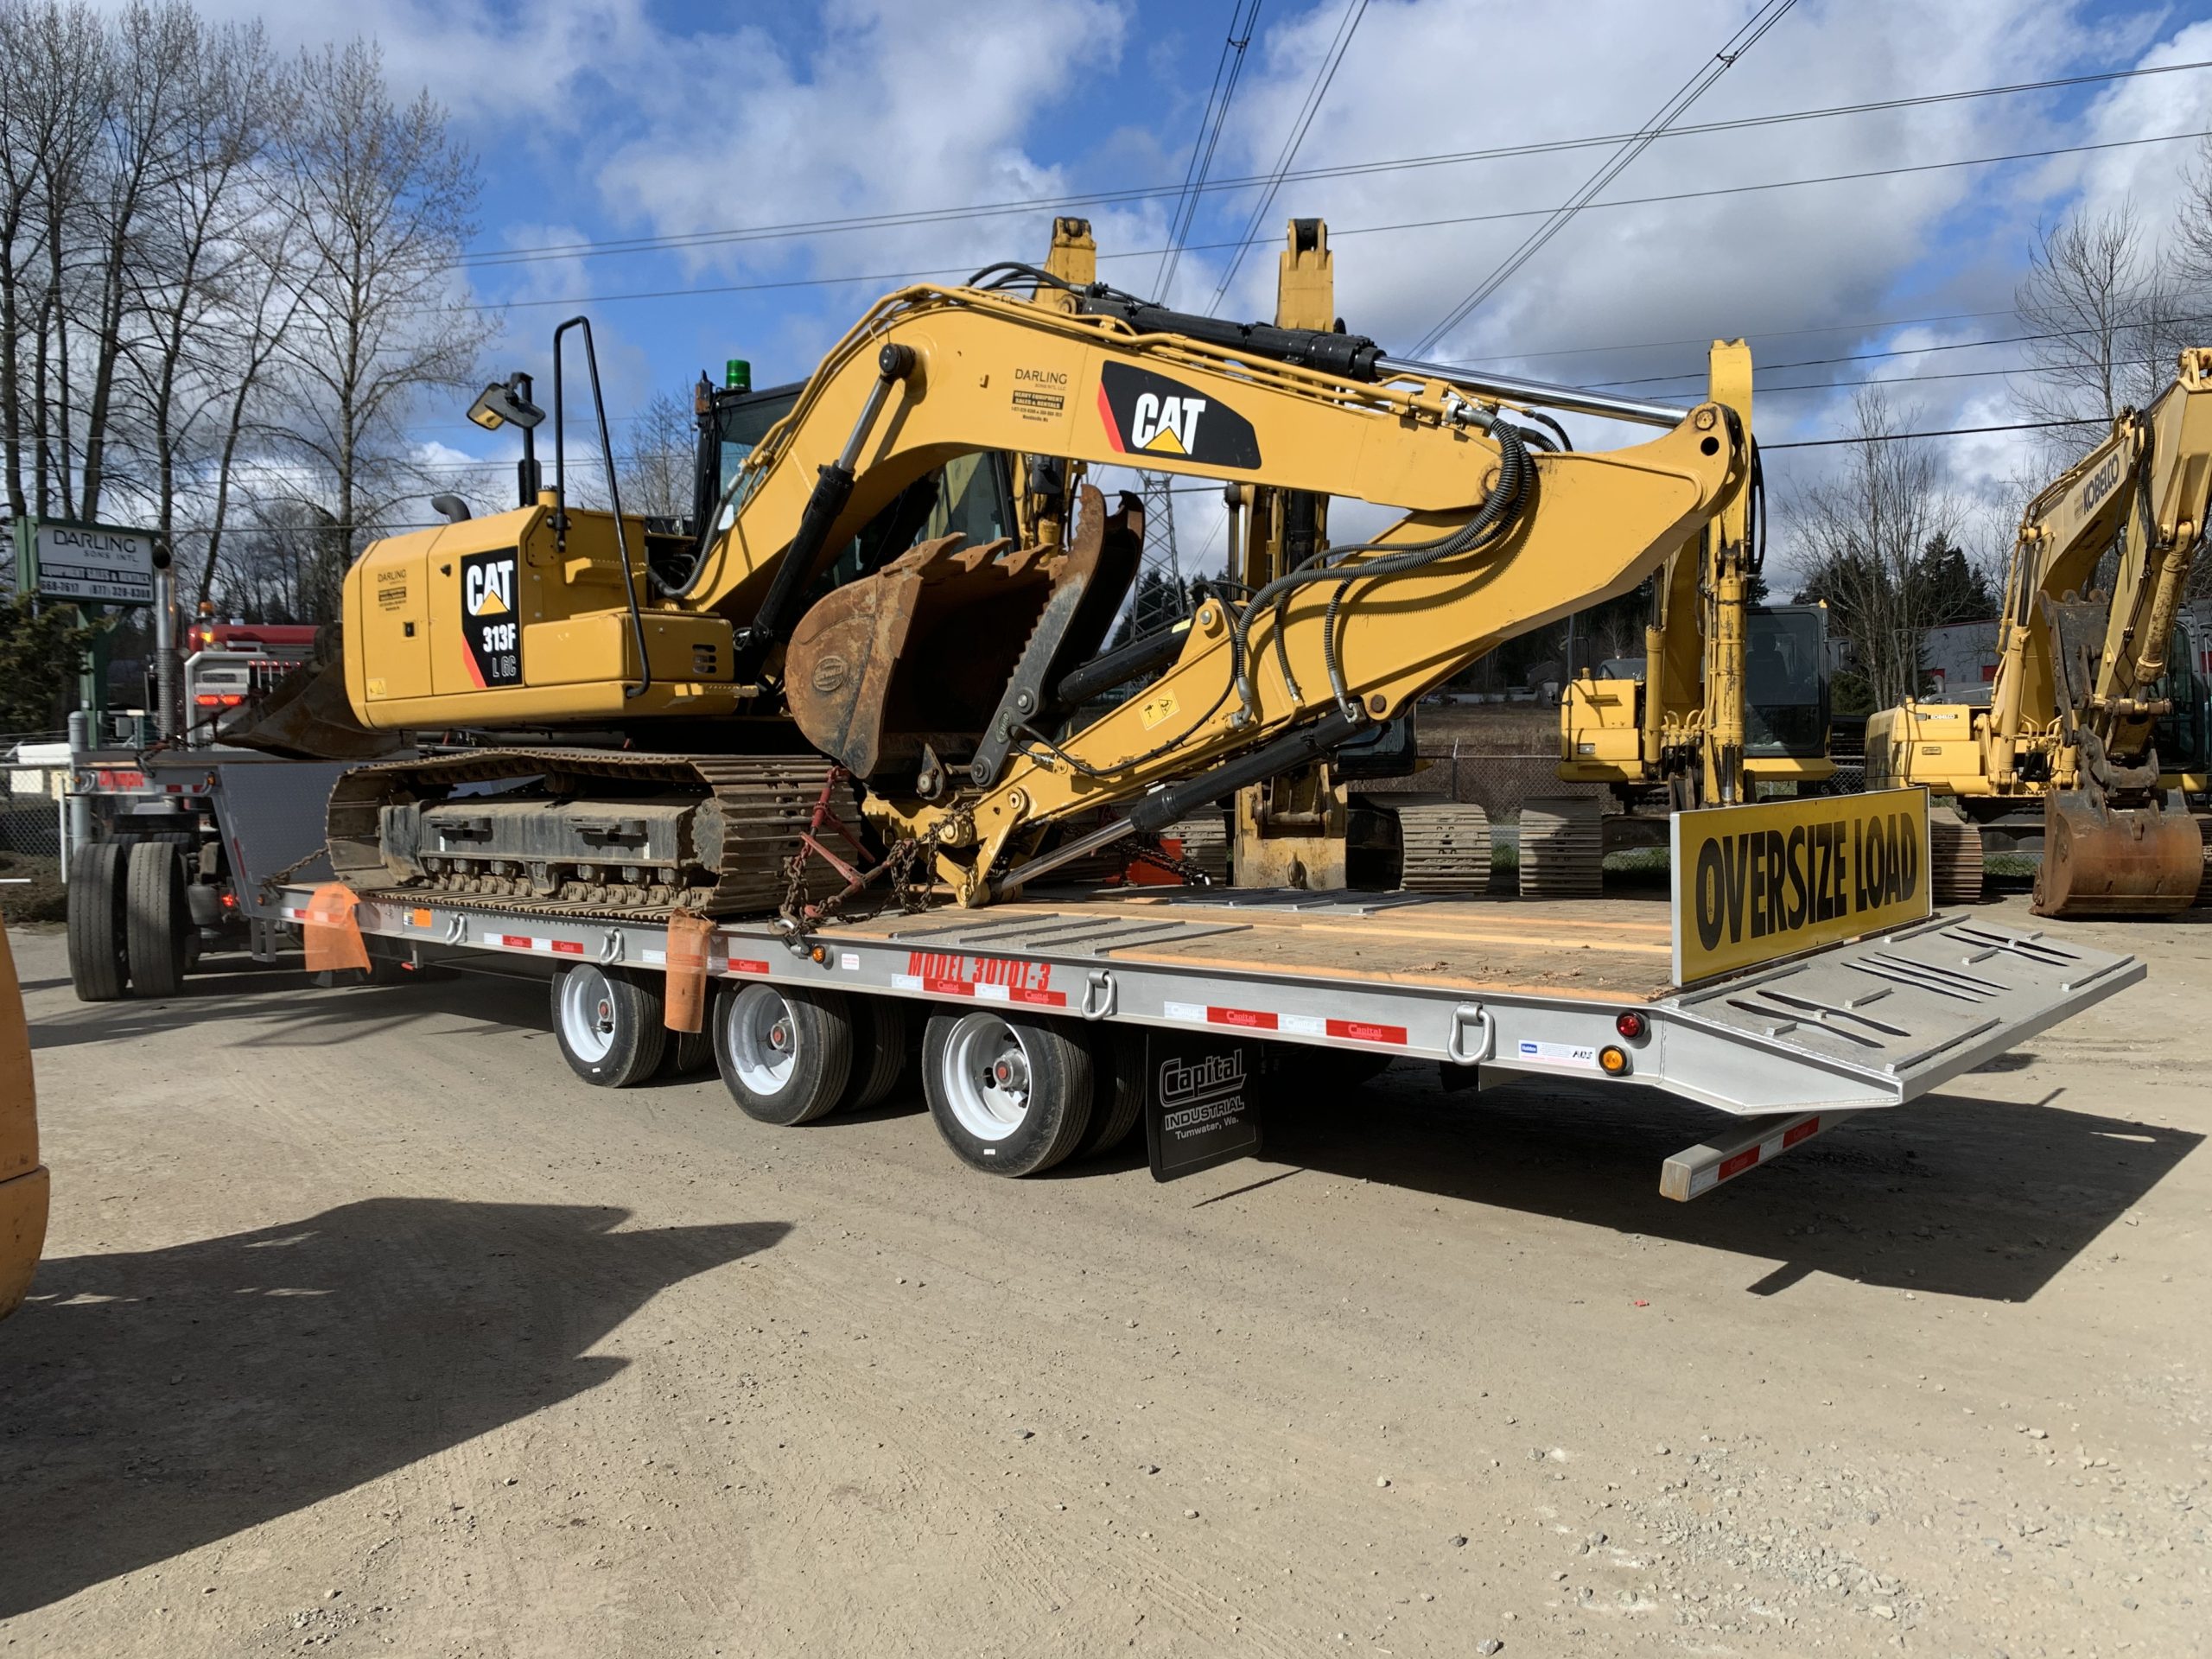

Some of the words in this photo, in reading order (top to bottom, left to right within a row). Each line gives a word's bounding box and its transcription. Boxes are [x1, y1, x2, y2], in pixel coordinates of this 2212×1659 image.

[1015, 368, 1068, 385] DARLING
[1132, 393, 1206, 455] CAT
[2083, 453, 2120, 516] KOBELCO
[54, 530, 137, 553] DARLING
[84, 550, 111, 559] SONS
[467, 559, 514, 616] CAT
[483, 623, 516, 652] 313F
[493, 657, 499, 677] L
[501, 655, 517, 677] GC
[1696, 821, 1847, 951] OVERSIZE
[1854, 812, 1917, 913] LOAD
[907, 951, 964, 982] MODEL
[1226, 1011, 1256, 1023] Capital
[1348, 1024, 1382, 1037] Capital
[1159, 1048, 1247, 1107] Capital
[1165, 1095, 1244, 1131] INDUSTRIAL
[1175, 1122, 1222, 1140] Tumwater,
[1224, 1116, 1239, 1126] Wa.
